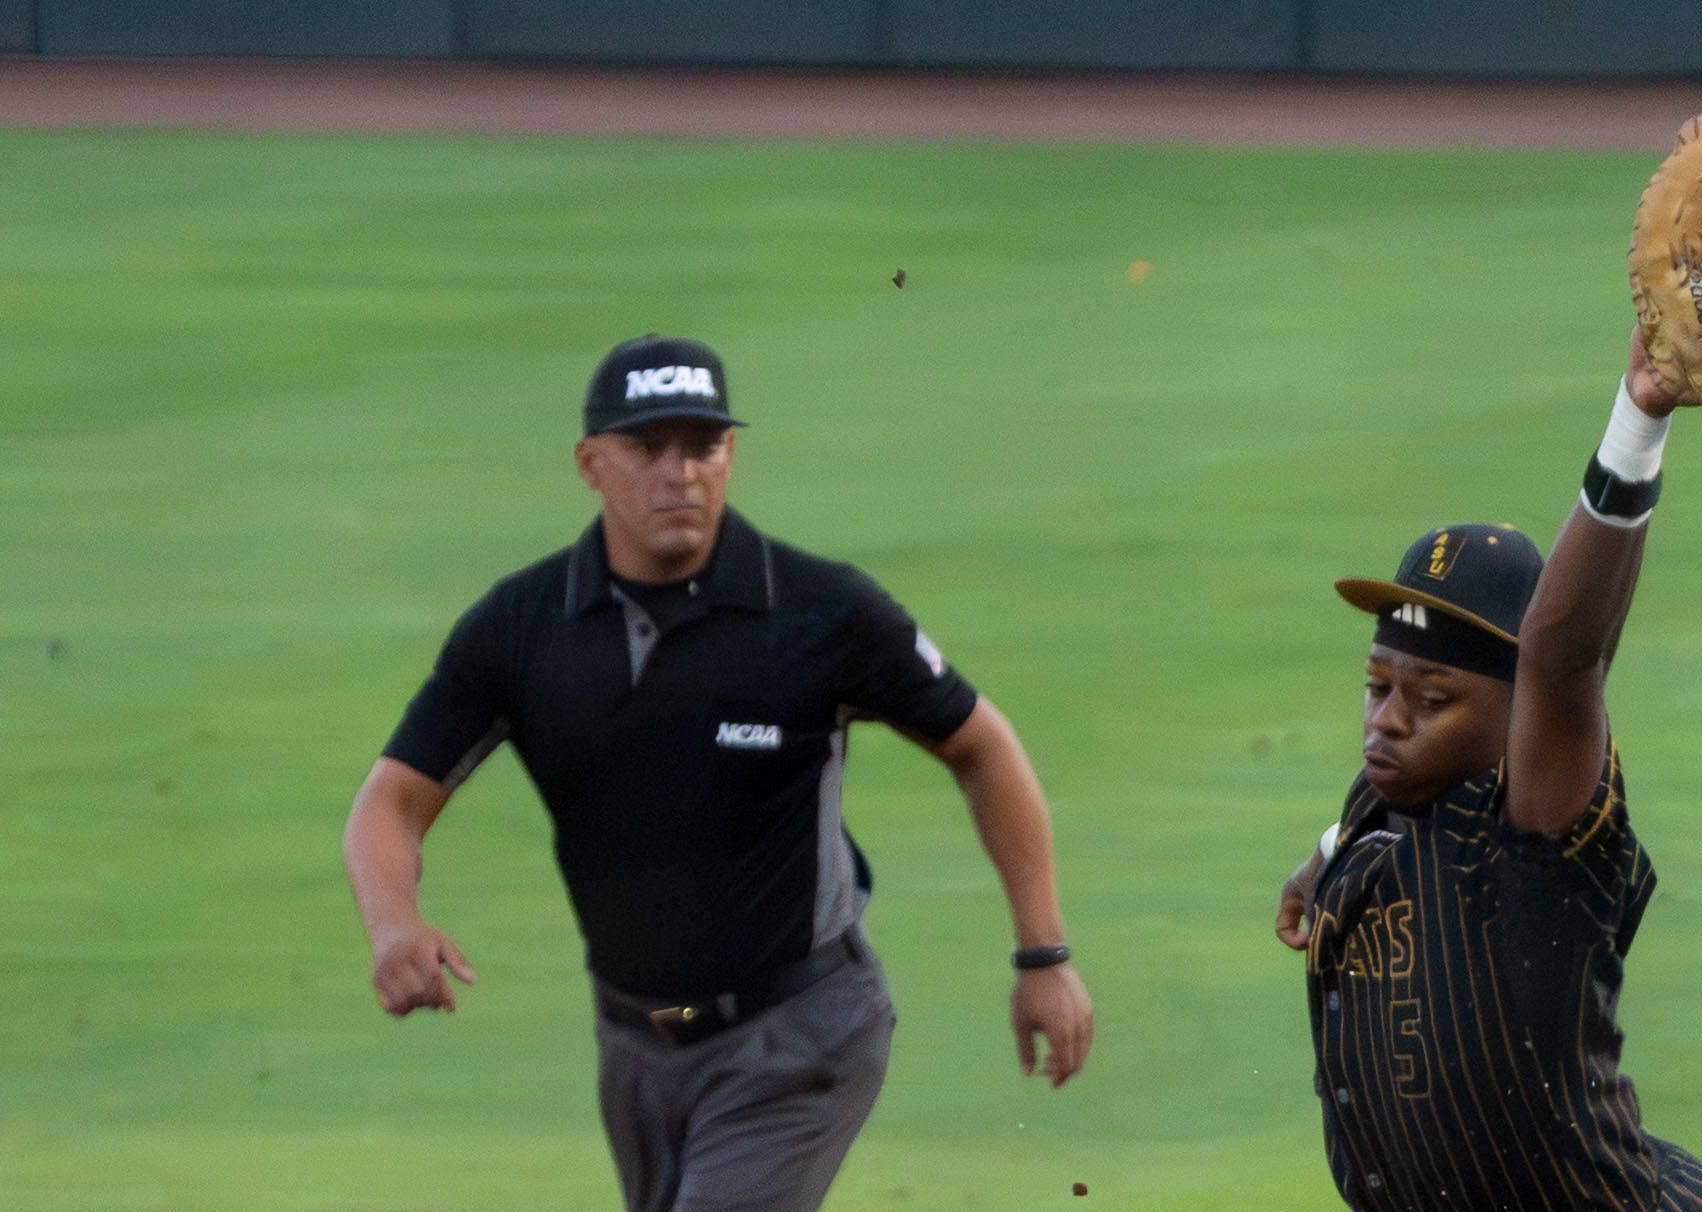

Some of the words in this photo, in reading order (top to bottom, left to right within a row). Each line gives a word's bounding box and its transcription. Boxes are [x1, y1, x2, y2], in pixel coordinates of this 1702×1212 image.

[625, 366, 716, 400] NCAA
[1429, 532, 1450, 574] ASU
[715, 721, 782, 748] NCAA
[1390, 999, 1431, 1099] 5
